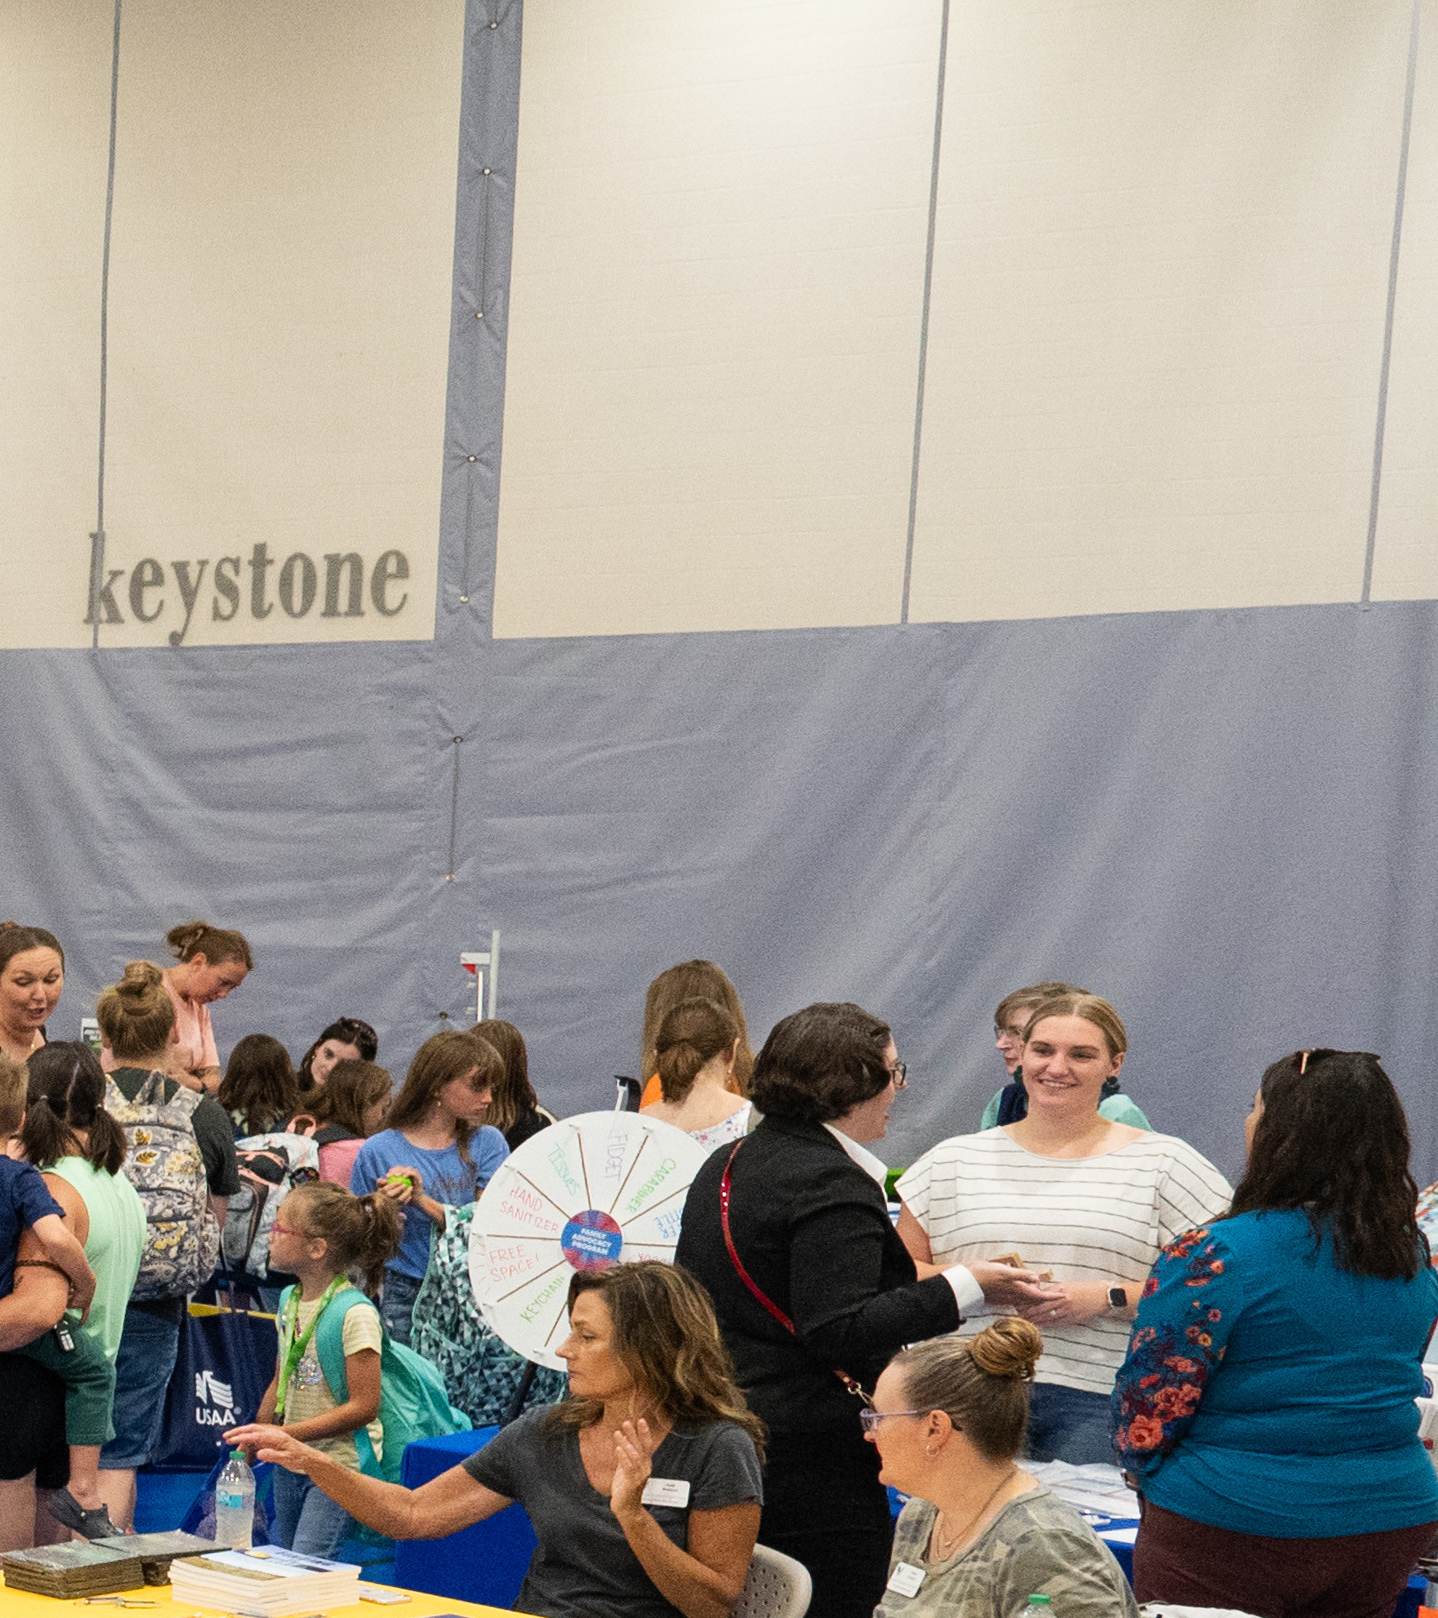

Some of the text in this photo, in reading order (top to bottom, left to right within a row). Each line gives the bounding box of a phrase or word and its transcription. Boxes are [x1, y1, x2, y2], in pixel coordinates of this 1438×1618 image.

[84, 531, 409, 647] keystone
[509, 1186, 543, 1211] HAND
[500, 1200, 559, 1233] SANITIZER
[571, 1233, 612, 1248] ADVOCACY
[580, 1227, 607, 1240] FAMILY
[489, 1245, 525, 1265] FREE
[571, 1240, 608, 1256] PROGRAM
[196, 1407, 236, 1426] USAA
